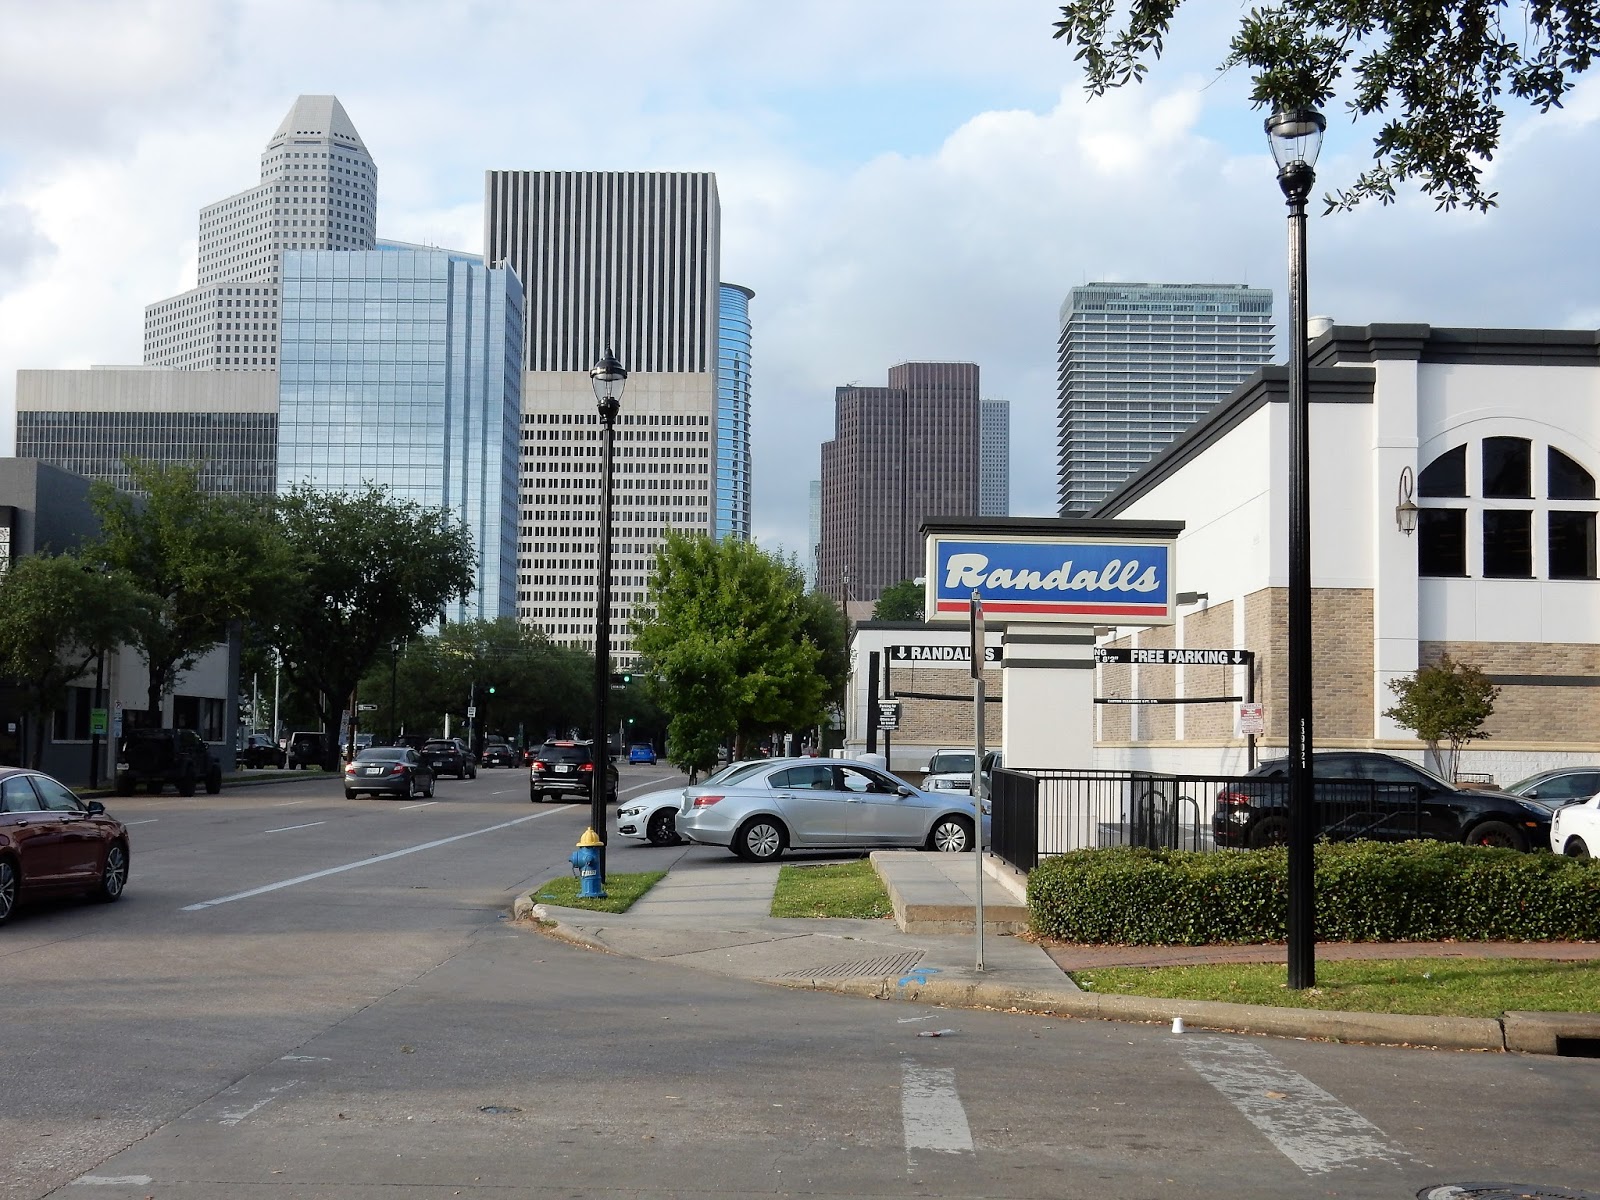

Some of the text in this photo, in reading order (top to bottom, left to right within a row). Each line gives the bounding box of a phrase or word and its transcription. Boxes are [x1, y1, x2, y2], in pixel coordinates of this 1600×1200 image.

[945, 553, 1160, 593] Randalls
[911, 647, 995, 661] RANDALS
[1130, 650, 1228, 664] FREE PARKING
